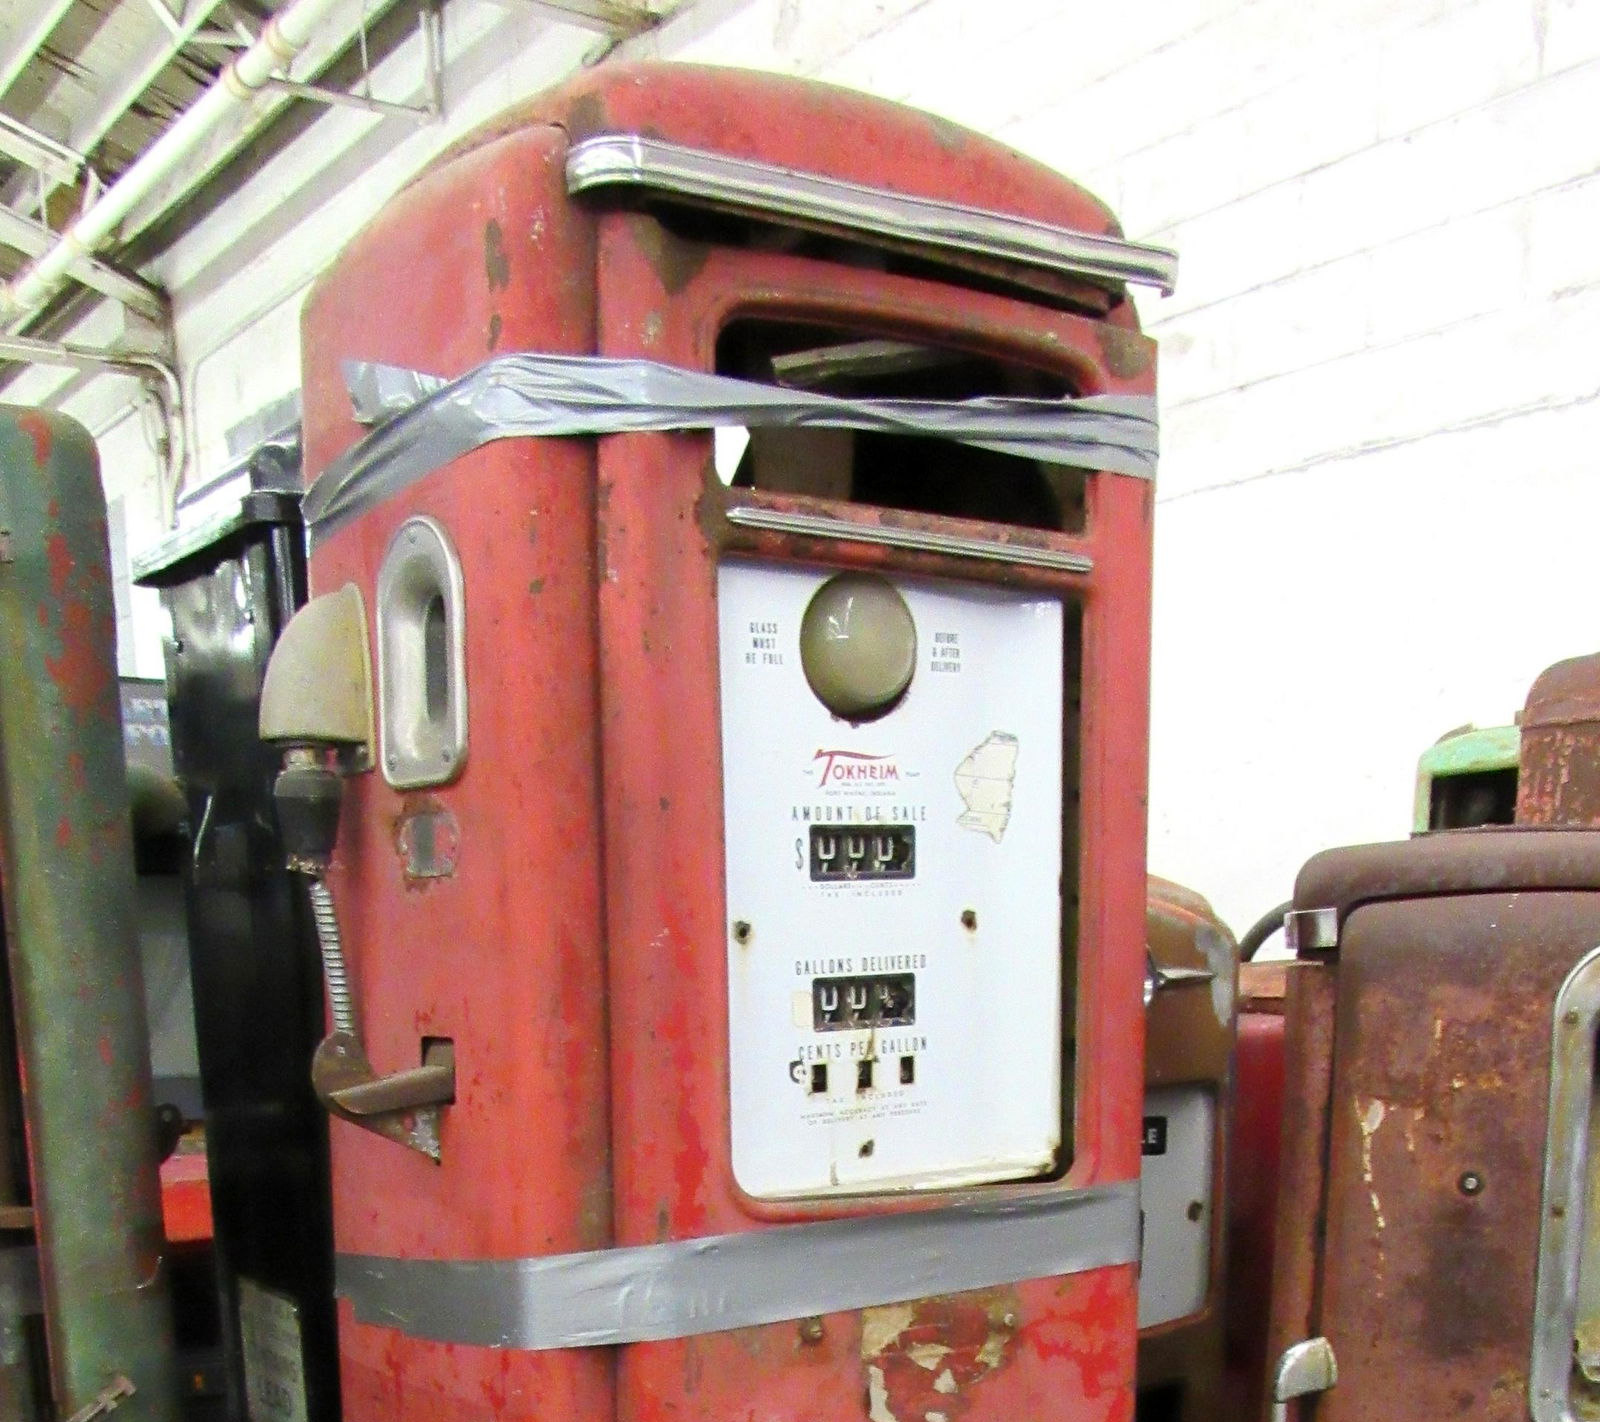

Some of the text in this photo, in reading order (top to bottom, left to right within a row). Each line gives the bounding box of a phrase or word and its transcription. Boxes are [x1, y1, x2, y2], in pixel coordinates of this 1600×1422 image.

[813, 748, 899, 788] TOKHEIM
[791, 806, 927, 821] AMOUNT OF SALE
[795, 954, 927, 976] GALLONS DELIVERED
[798, 1043, 841, 1060] CENTS
[882, 1036, 927, 1054] GALLON
